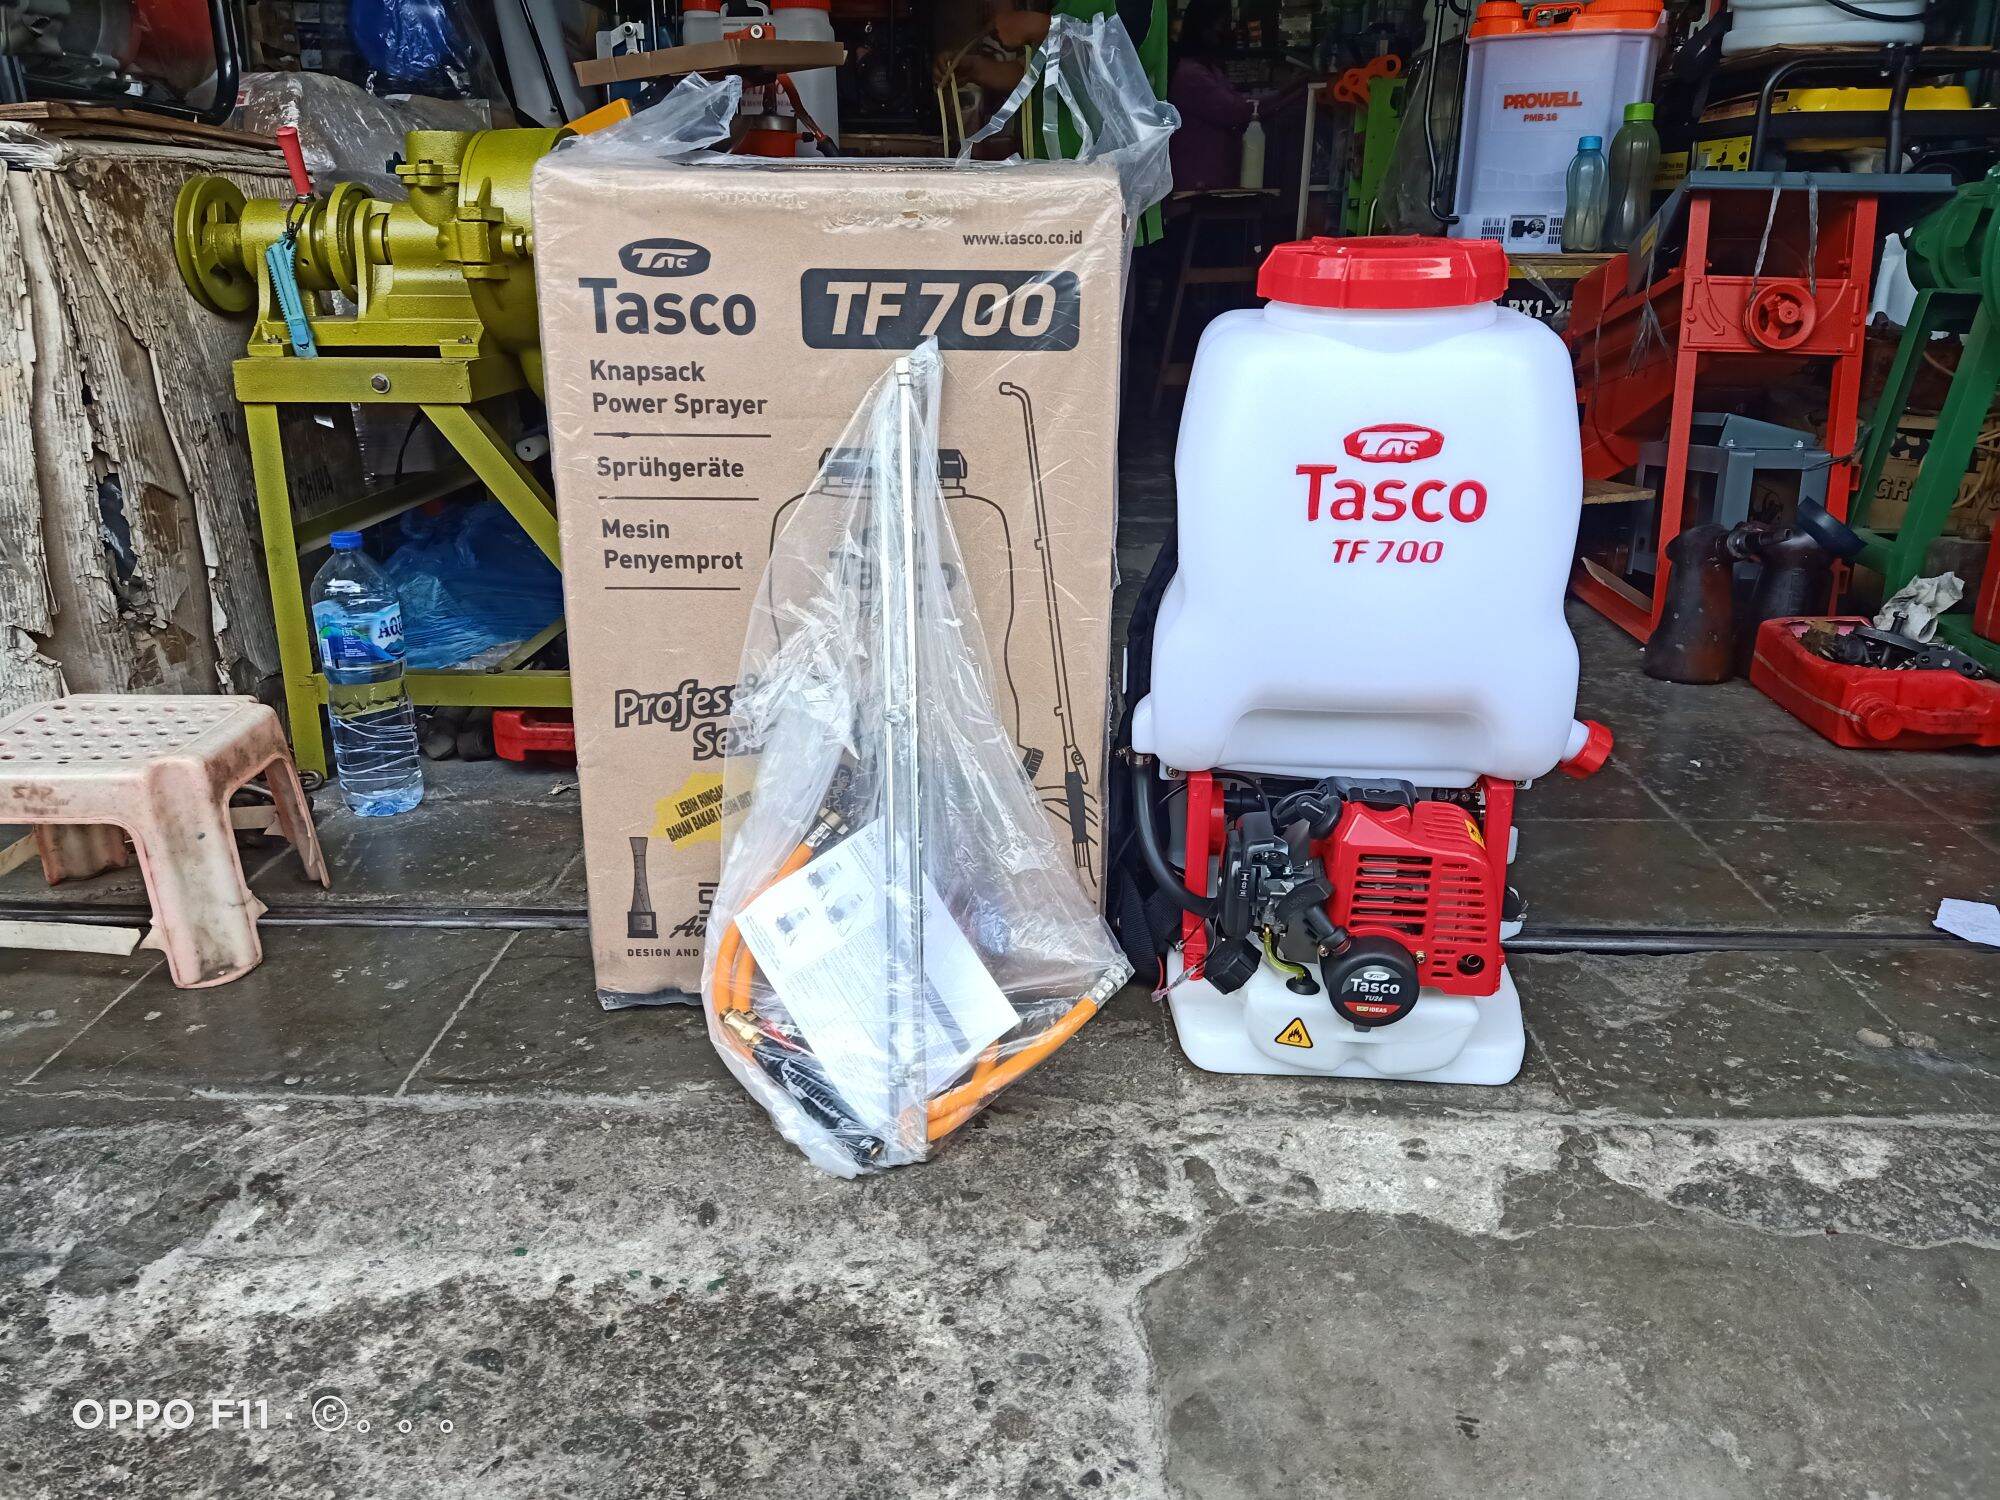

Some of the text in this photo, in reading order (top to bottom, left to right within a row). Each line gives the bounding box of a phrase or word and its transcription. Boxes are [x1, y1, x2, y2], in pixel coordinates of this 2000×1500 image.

[1503, 91, 1583, 109] PROWELL
[1523, 113, 1558, 122] PMB-16
[963, 231, 1083, 245] www.tasco.co.id
[578, 277, 757, 336] Tasco
[826, 281, 1056, 337] TF 700
[590, 359, 706, 386] Knapsack
[592, 392, 768, 419] Power Sprayer
[597, 456, 744, 482] Sprühgeräte
[1296, 464, 1487, 523] Tasco
[602, 519, 669, 539] Mesin
[604, 549, 743, 574] Penyemprot
[1333, 539, 1444, 564] TF 700
[675, 794, 700, 818] LEBIH
[665, 820, 695, 843] BAHAN
[692, 806, 718, 831] BAKAR
[627, 948, 699, 957] DESIGN AND
[1350, 978, 1400, 994] Tasco
